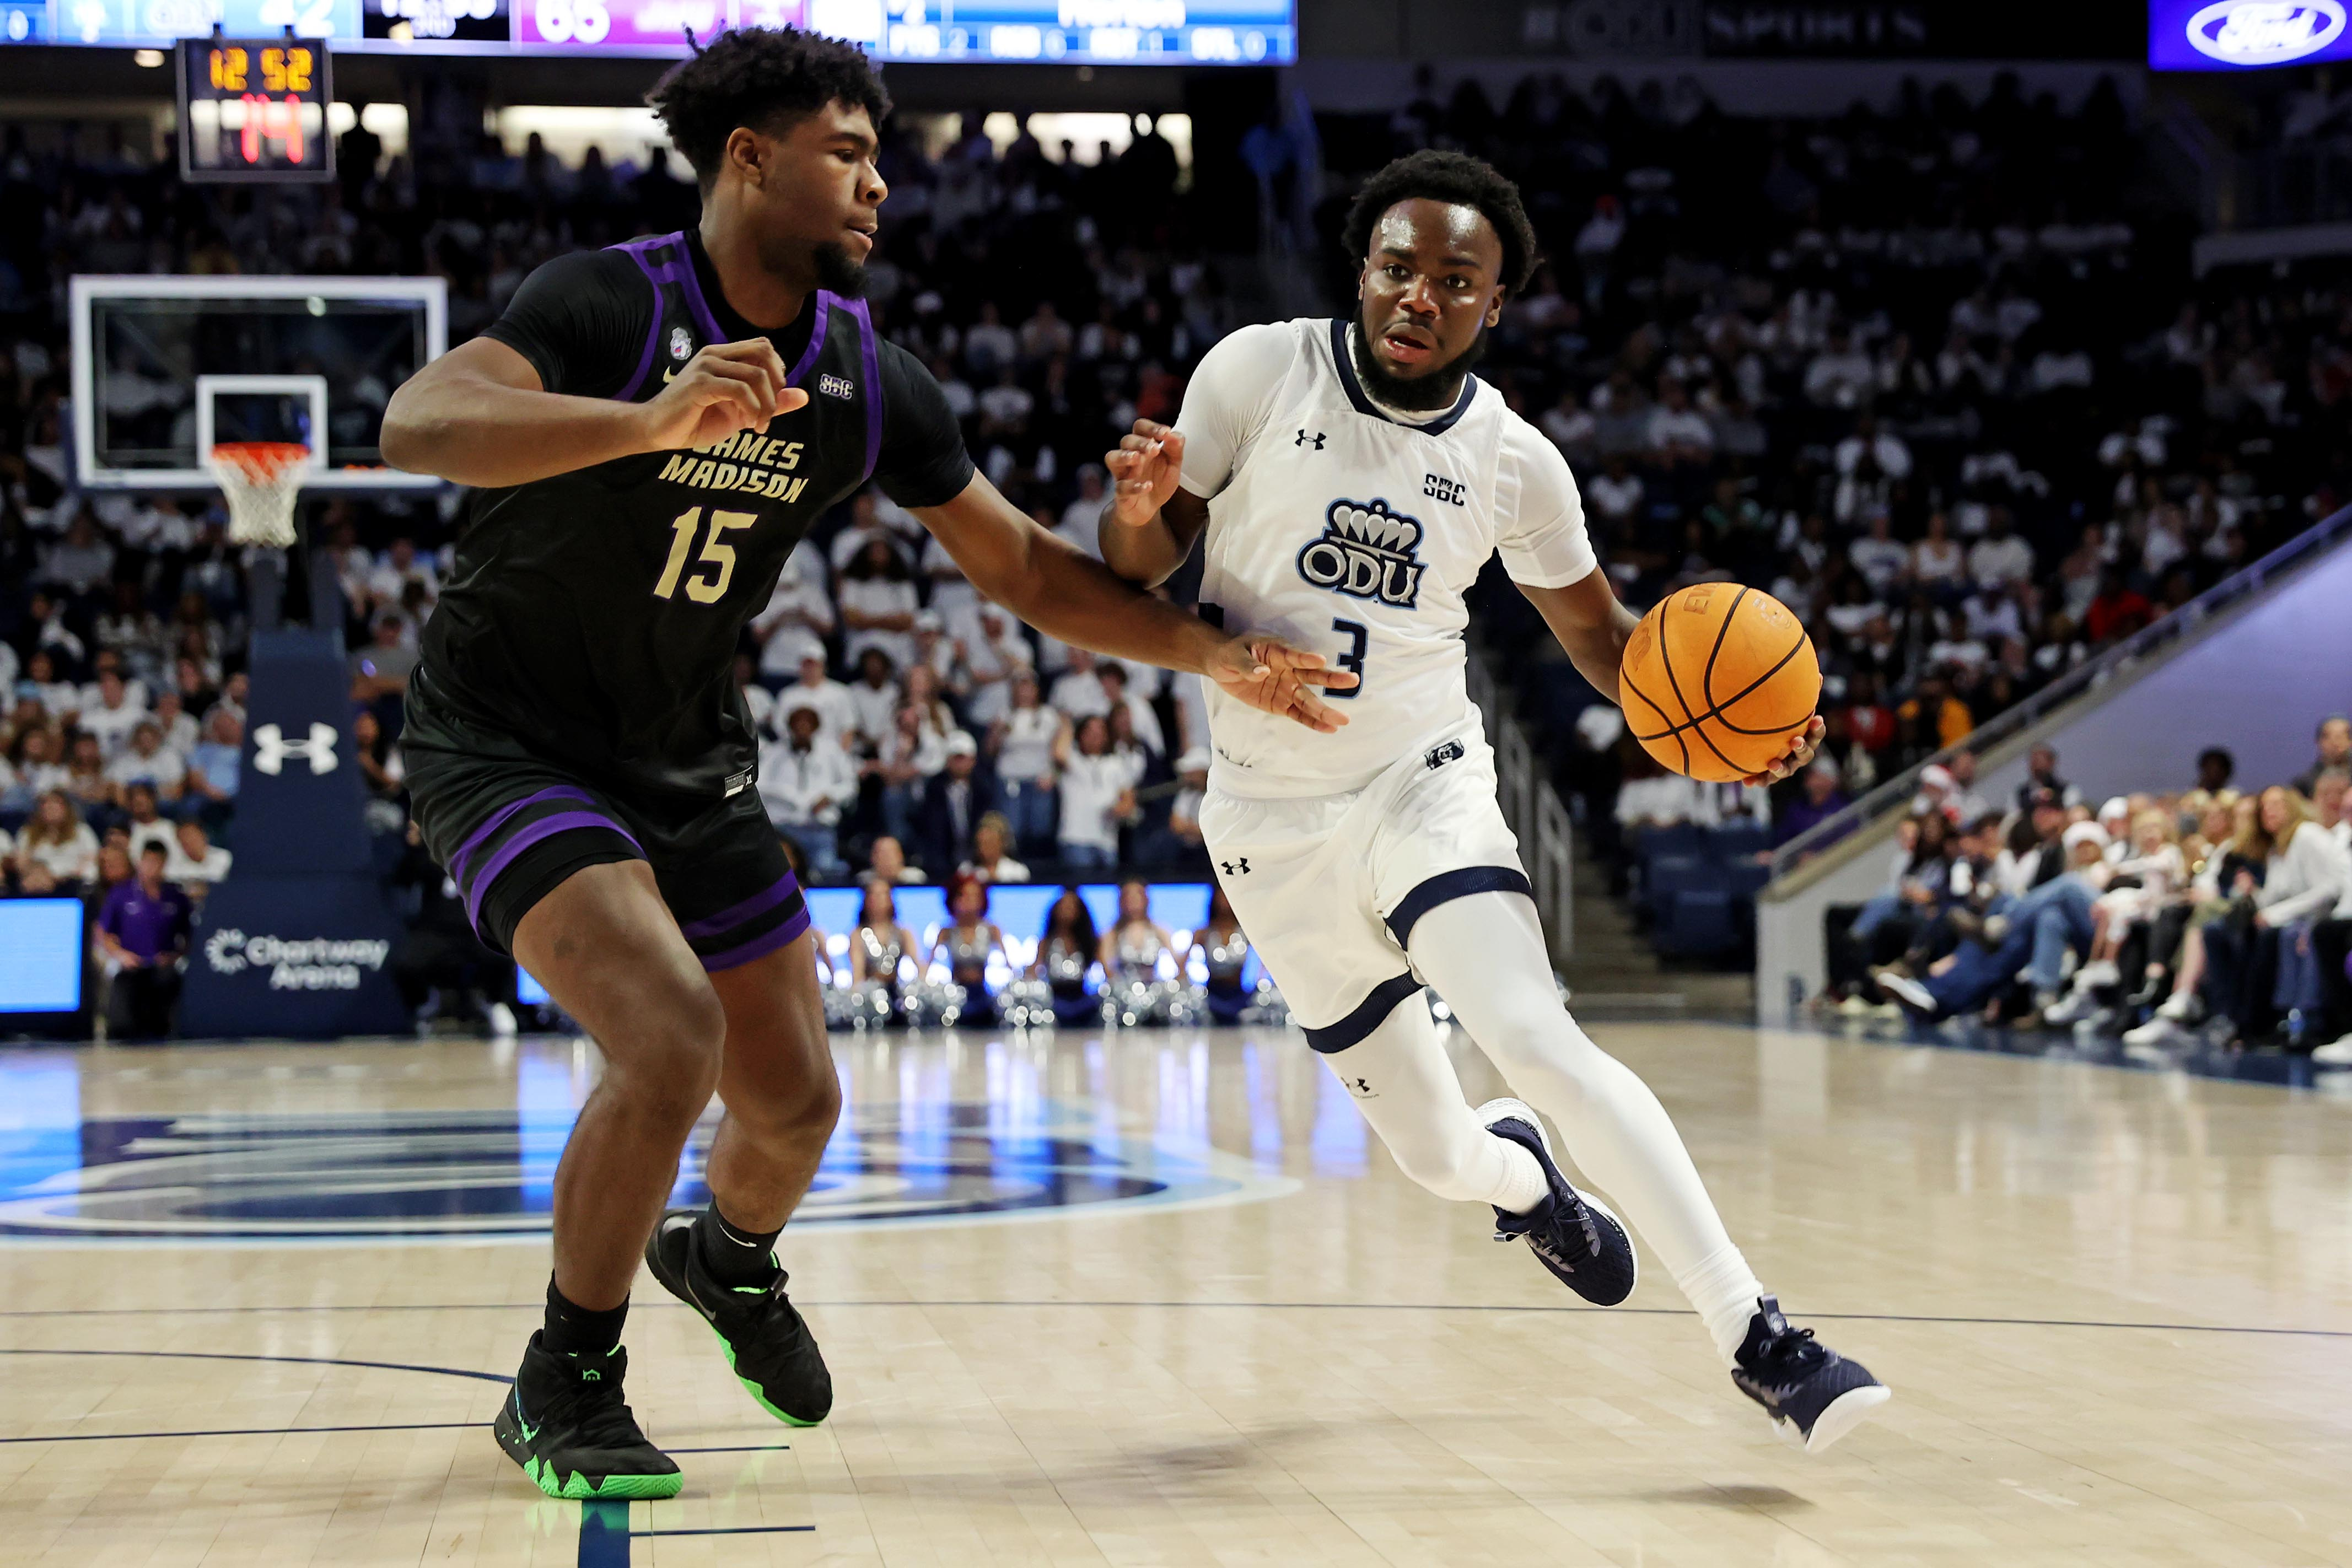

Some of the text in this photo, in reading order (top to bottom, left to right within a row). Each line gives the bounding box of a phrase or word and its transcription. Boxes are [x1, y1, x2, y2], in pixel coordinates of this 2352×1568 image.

[2218, 2, 2314, 54] Ford
[820, 373, 853, 400] SBC
[658, 454, 809, 504] MADISON
[1423, 473, 1466, 506] SBC
[653, 506, 758, 604] 15
[1300, 542, 1423, 605] ODU
[1323, 617, 1368, 698] 3
[745, 774, 753, 786] XL
[245, 935, 390, 972] Chartway
[269, 961, 361, 991] Arena
